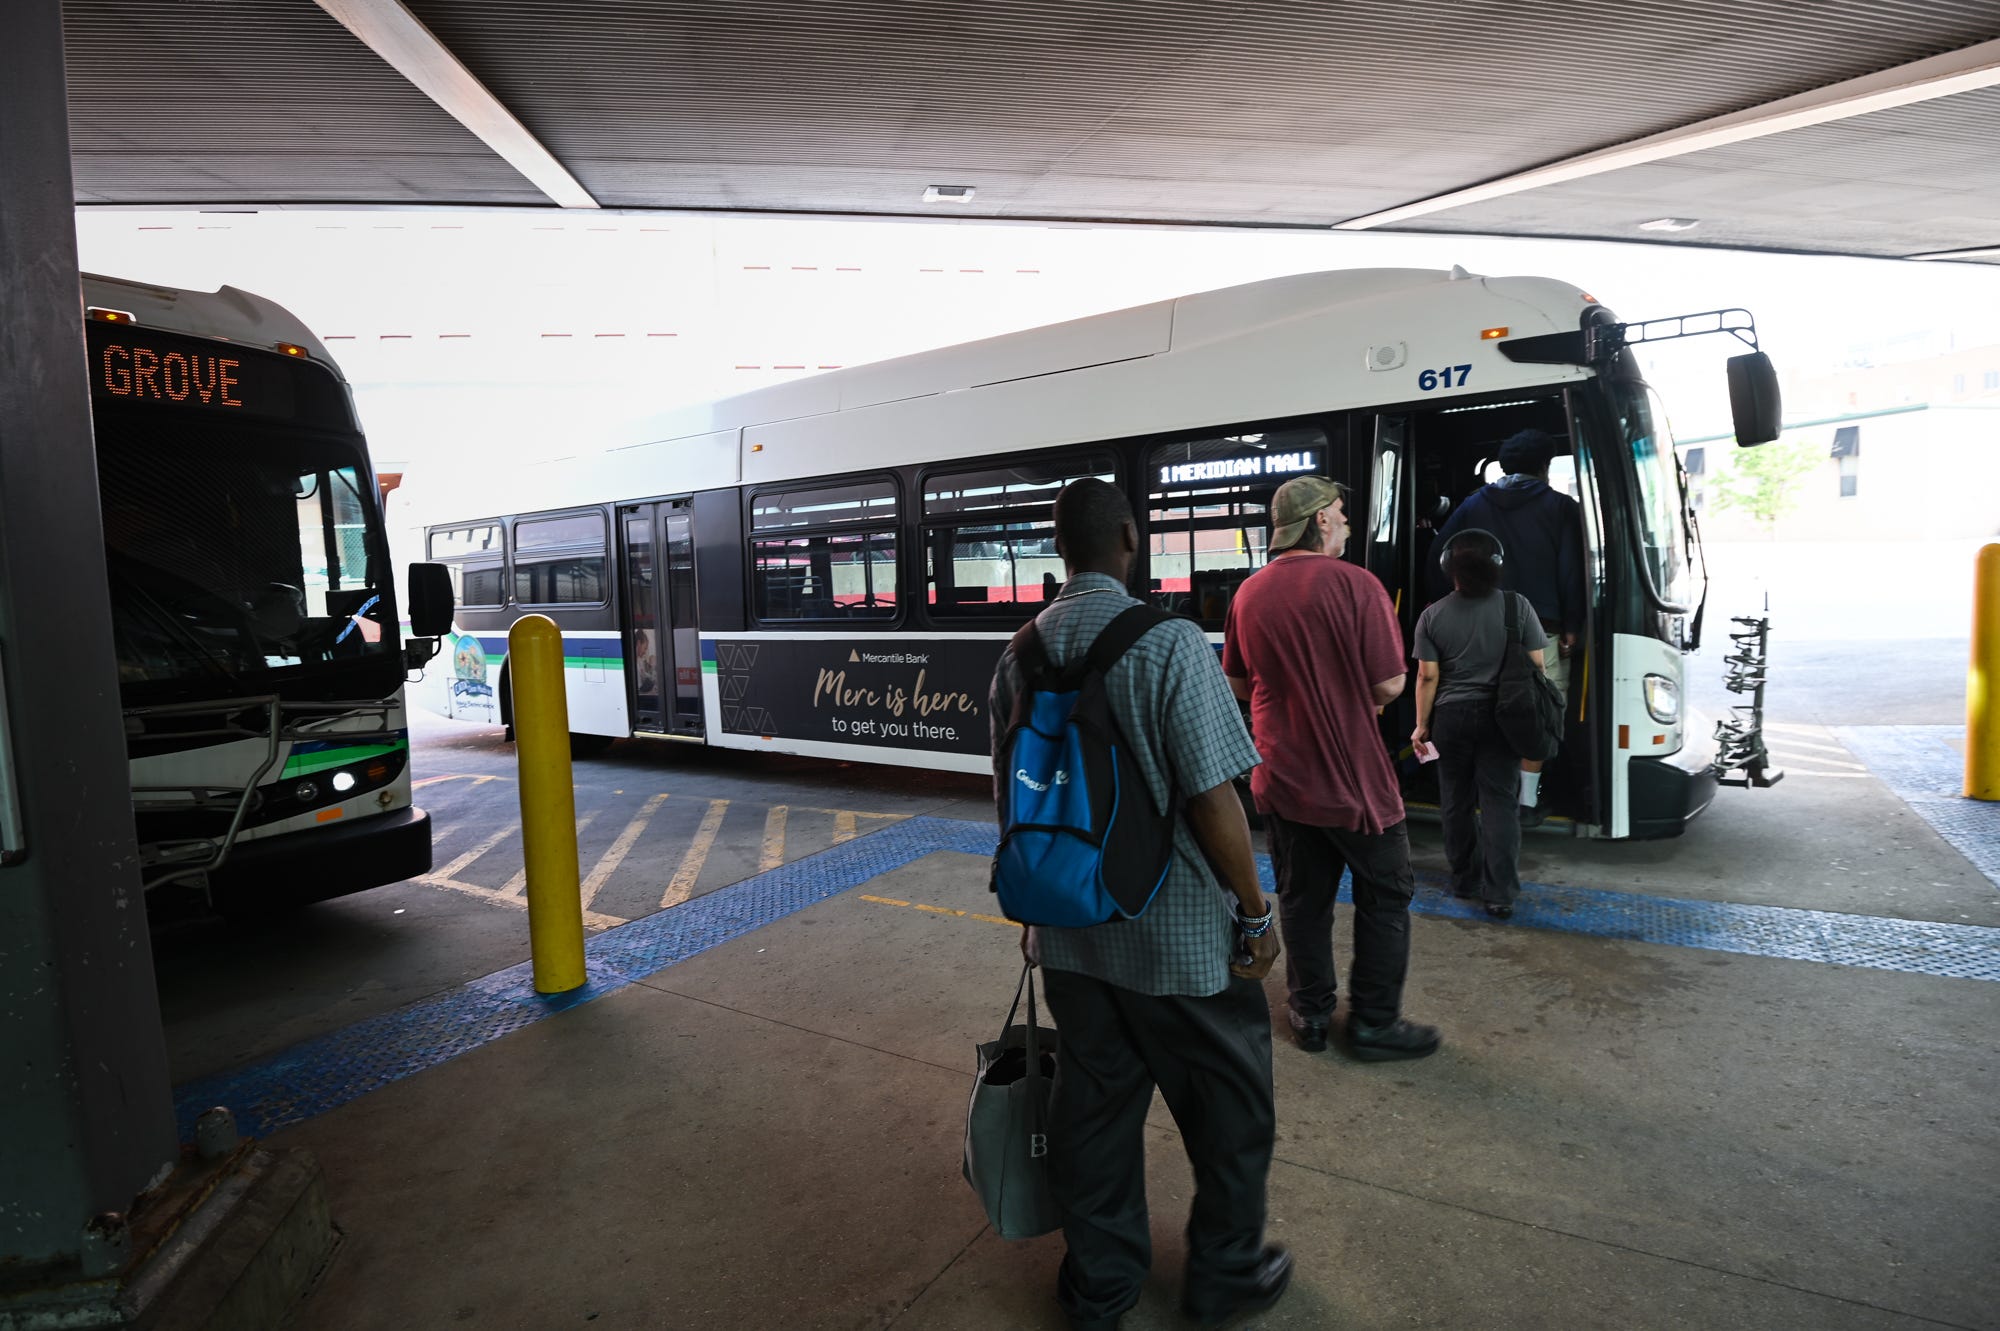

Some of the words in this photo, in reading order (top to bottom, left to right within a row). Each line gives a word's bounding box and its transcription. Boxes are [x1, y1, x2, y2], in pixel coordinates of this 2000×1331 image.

[103, 344, 242, 407] GROVE
[1418, 363, 1472, 391] 617
[1160, 466, 1171, 483] 1
[1171, 457, 1261, 482] MERIDIAN
[1265, 451, 1316, 473] MALL
[862, 653, 905, 663] Mercantile
[905, 653, 928, 664] Bank
[813, 667, 881, 708] Merc
[885, 683, 909, 717] is
[912, 668, 979, 717] here,
[832, 717, 848, 732] to
[851, 719, 876, 736] get
[880, 722, 908, 738] you
[912, 721, 960, 740] there.
